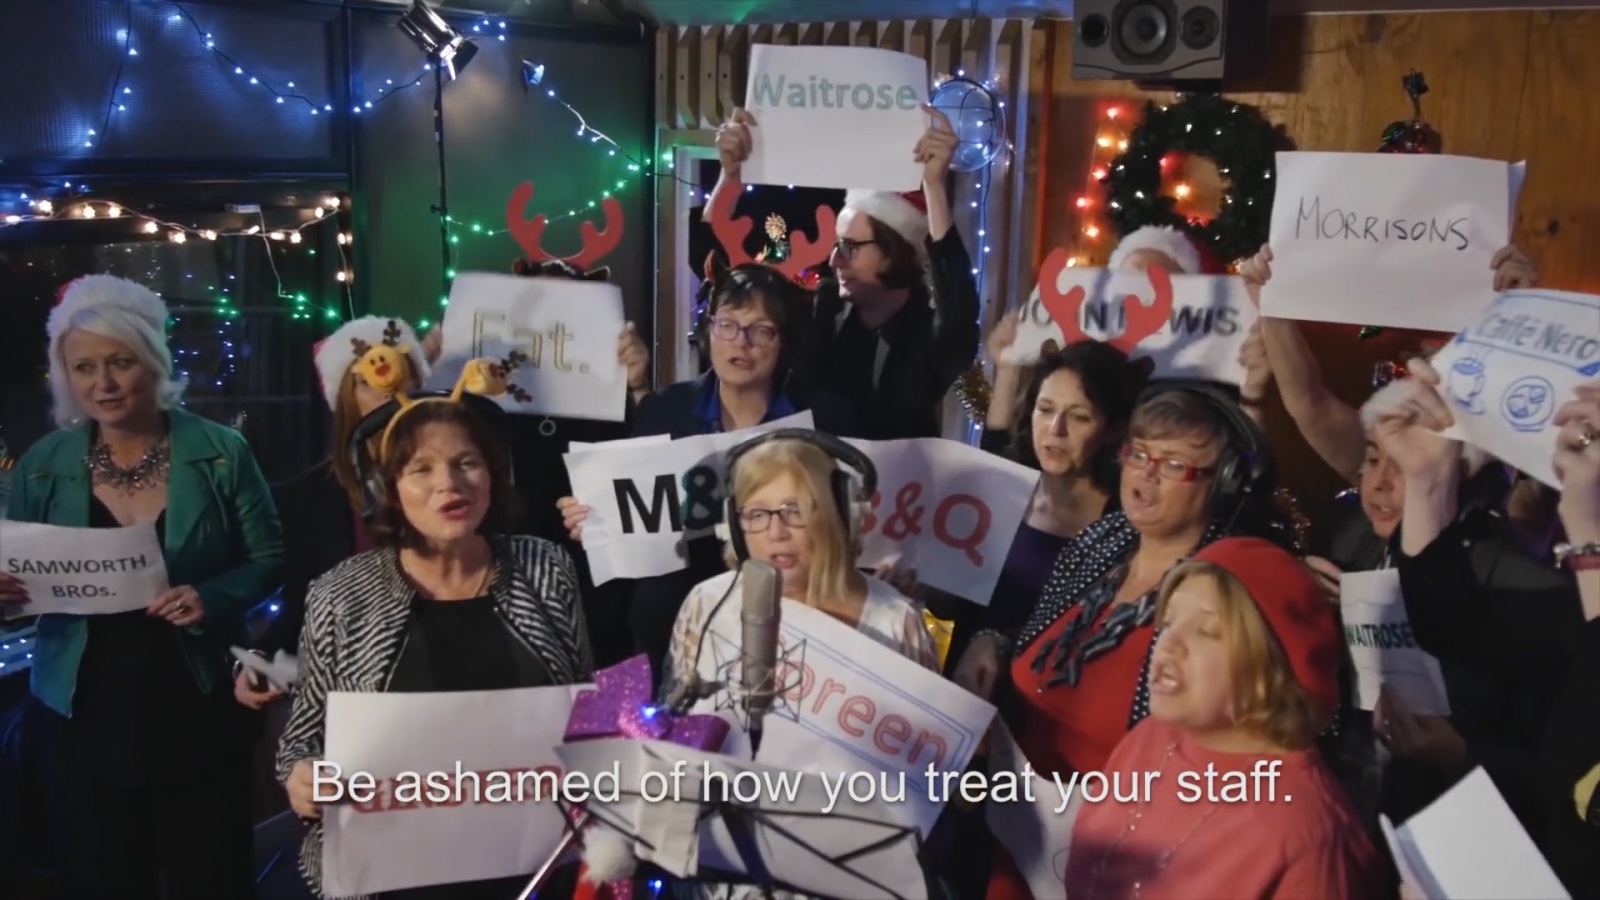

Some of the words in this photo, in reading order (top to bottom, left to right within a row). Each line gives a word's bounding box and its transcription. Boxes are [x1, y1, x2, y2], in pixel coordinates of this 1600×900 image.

[752, 73, 917, 111] Waitrose
[1295, 195, 1470, 251] MORRISONS
[1534, 323, 1600, 361] Nero
[8, 554, 146, 575] SAMWORTH
